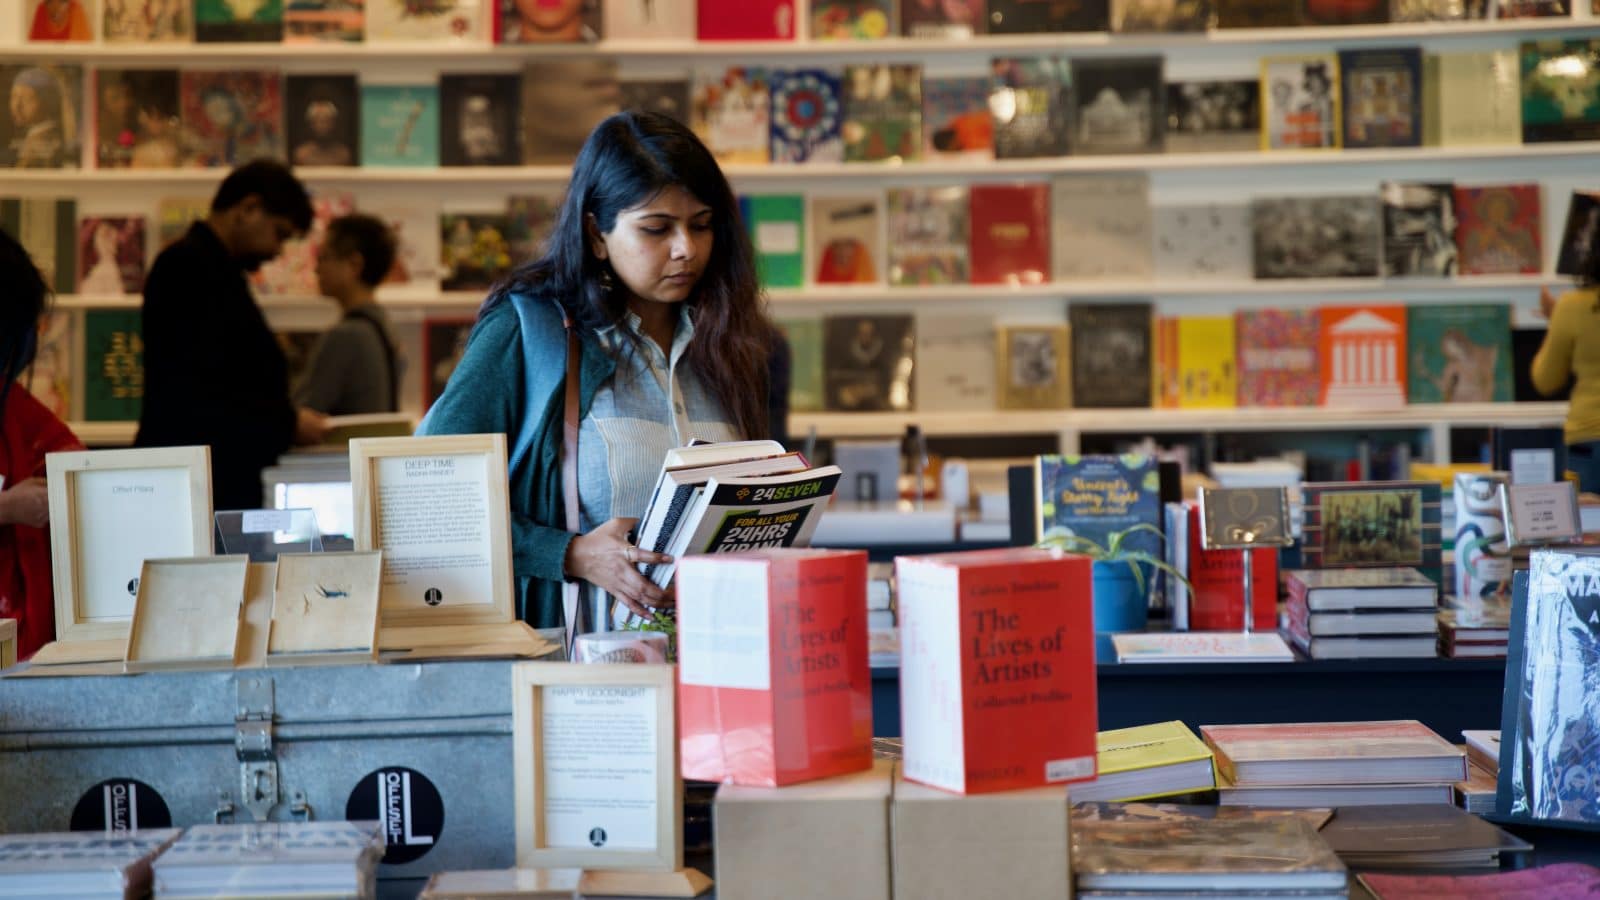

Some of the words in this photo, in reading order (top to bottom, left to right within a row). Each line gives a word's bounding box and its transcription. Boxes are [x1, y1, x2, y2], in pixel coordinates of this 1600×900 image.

[405, 459, 431, 470] DEEP
[434, 458, 455, 468] TIME
[752, 480, 822, 501] 24SEVEN
[735, 517, 755, 528] FOR
[755, 515, 775, 526] ALL
[775, 512, 800, 524] YOUR
[722, 522, 790, 544] 24HRS
[780, 603, 816, 624] The
[972, 608, 1020, 632] The
[781, 630, 827, 650] Lives
[831, 617, 849, 643] of
[973, 635, 1034, 659] Lives
[1040, 625, 1067, 652] of
[784, 652, 841, 675] Artists
[973, 658, 1053, 685] Artists
[552, 687, 584, 697] HAPPY
[386, 771, 403, 845] OFFSET
